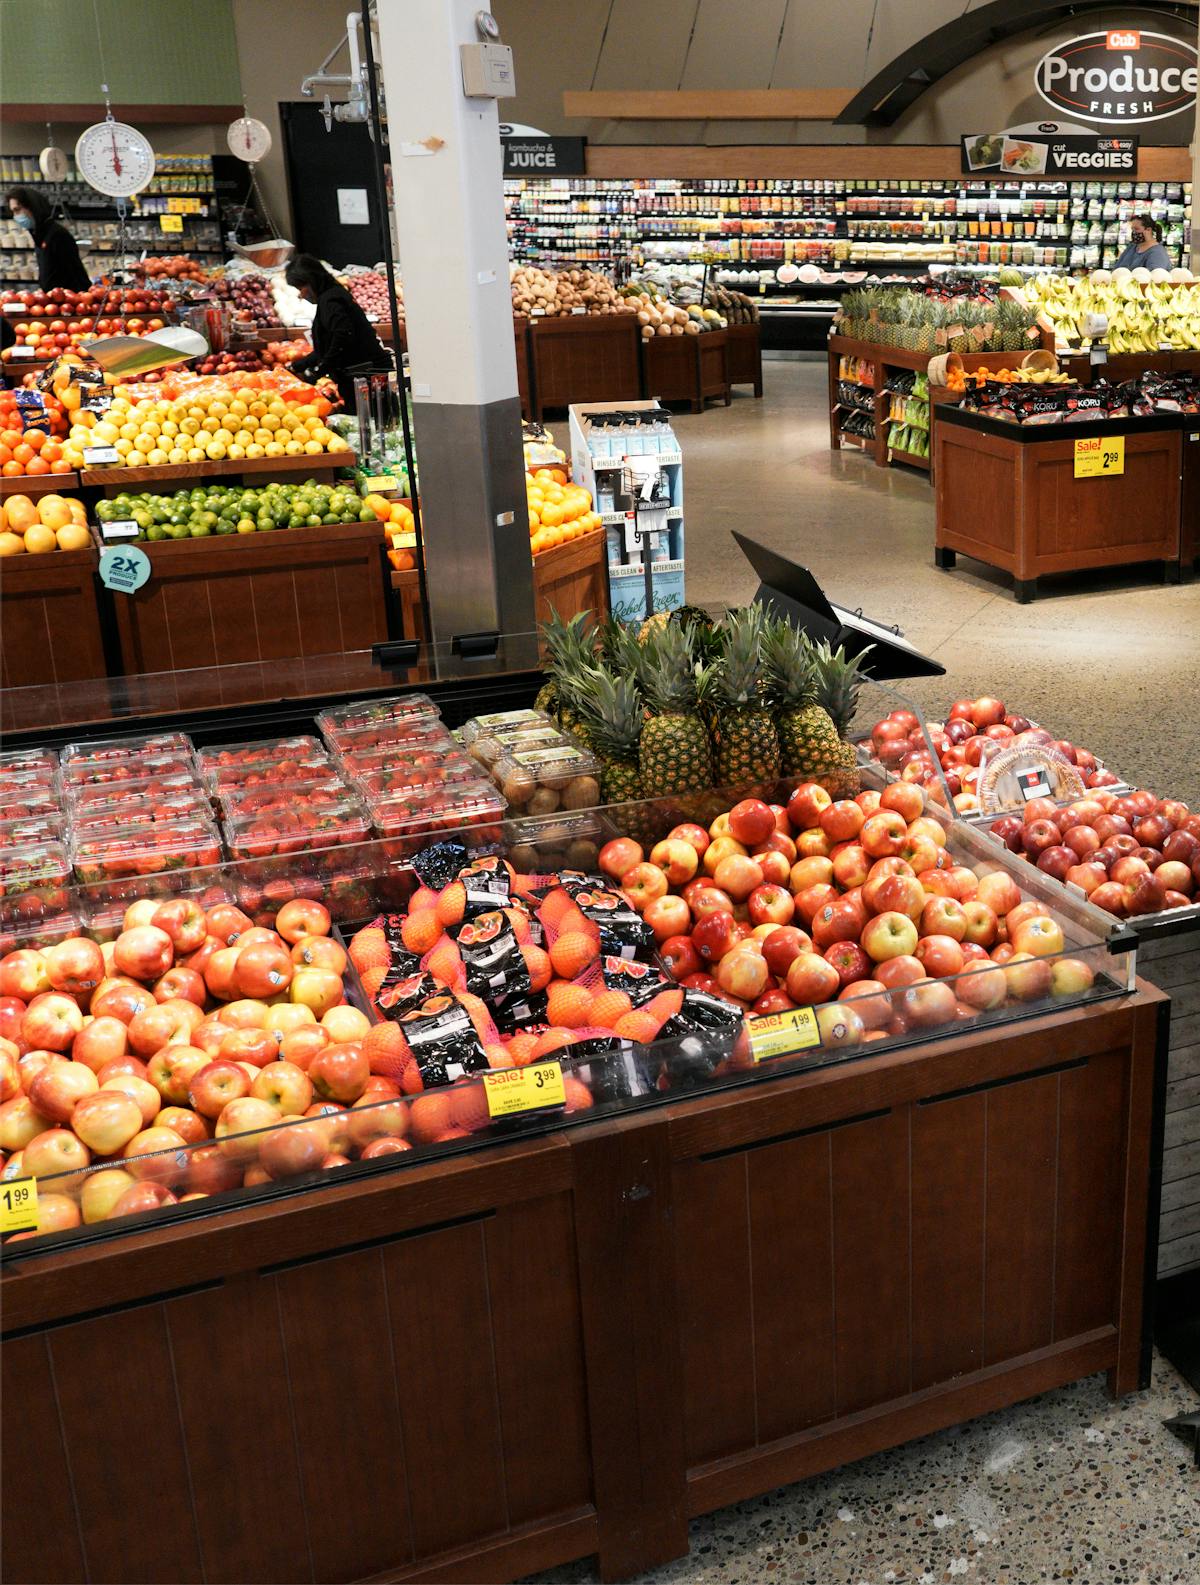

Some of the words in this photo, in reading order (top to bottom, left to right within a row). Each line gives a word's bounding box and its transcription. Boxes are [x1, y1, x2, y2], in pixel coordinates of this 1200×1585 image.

[1110, 33, 1137, 47] Cub
[1043, 55, 1199, 93] Produce
[1090, 100, 1154, 115] FRESH
[547, 143, 554, 152] &
[1052, 143, 1066, 152] cut
[509, 153, 556, 167] JUICE
[1053, 152, 1134, 168] VEGGIES
[1077, 398, 1101, 409] KORU
[1077, 437, 1102, 452] Sale!
[111, 556, 141, 574] 2X
[653, 562, 683, 572] AFTERTASTE
[749, 1013, 783, 1031] Sale!
[488, 1067, 525, 1086] Sale!
